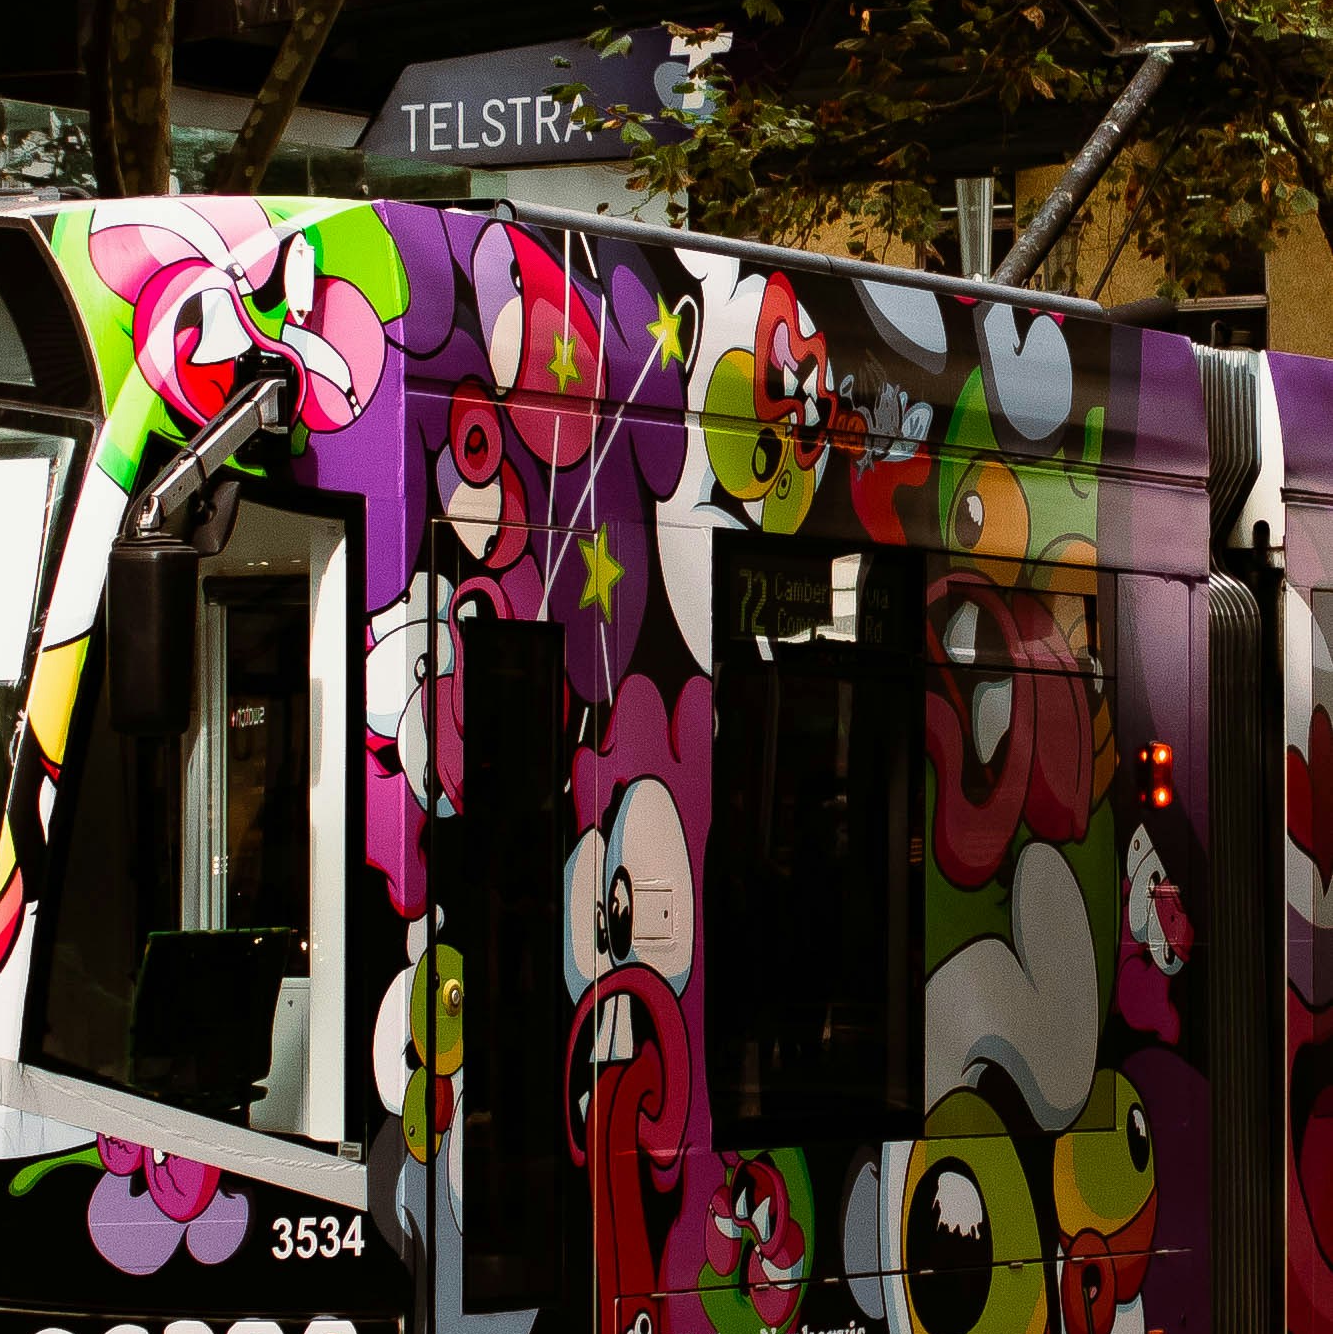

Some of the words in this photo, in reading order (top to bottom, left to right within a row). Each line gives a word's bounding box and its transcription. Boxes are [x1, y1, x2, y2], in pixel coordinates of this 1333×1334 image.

[400, 94, 594, 153] TELSTRA
[739, 569, 767, 633] 72
[271, 1215, 365, 1259] 3534
